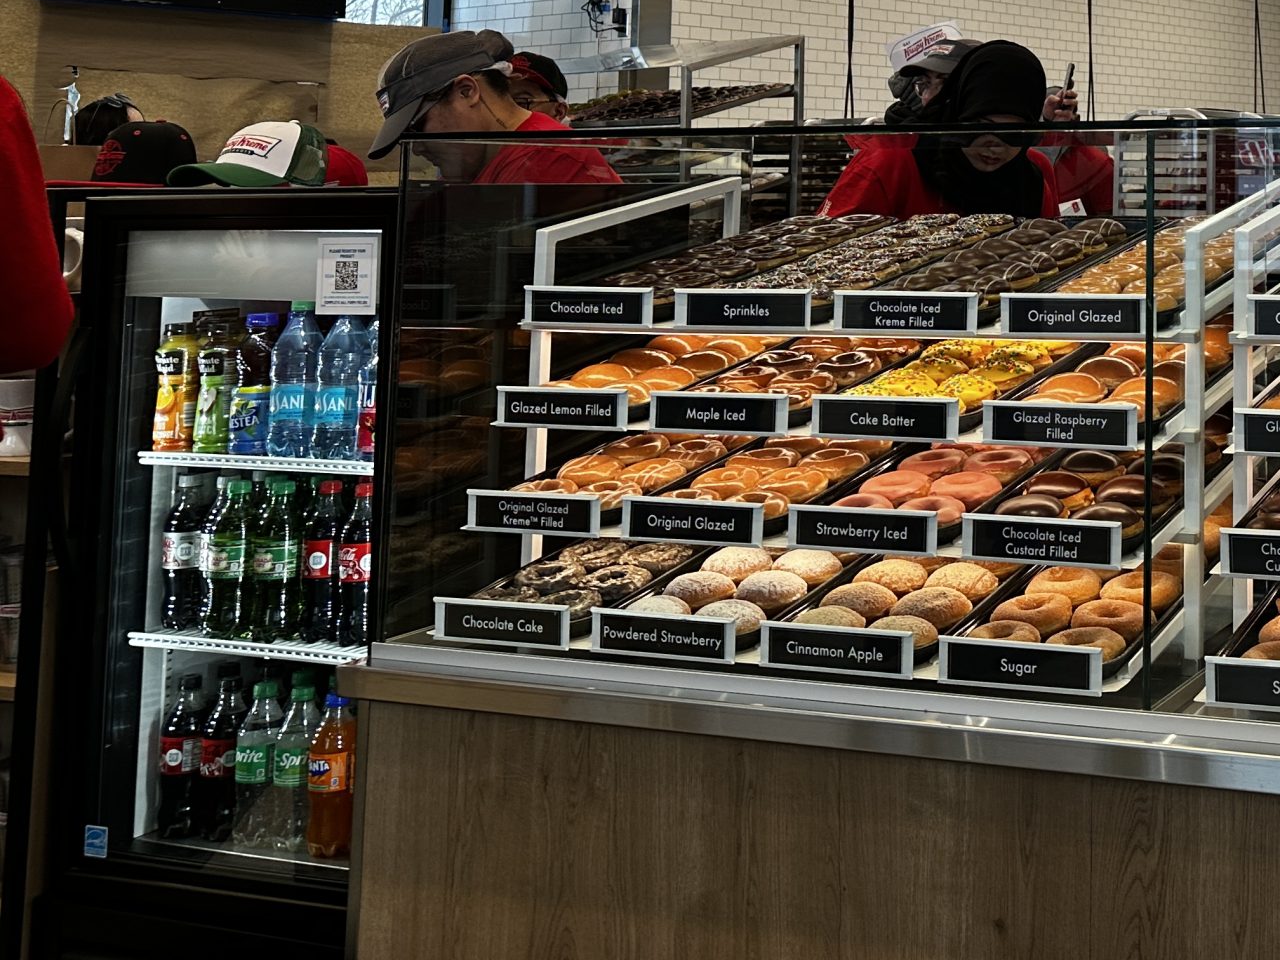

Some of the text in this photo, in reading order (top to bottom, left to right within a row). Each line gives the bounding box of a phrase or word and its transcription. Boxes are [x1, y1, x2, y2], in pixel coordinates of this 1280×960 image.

[550, 301, 623, 314] Chocolate Iced
[723, 304, 770, 319] Sprinkles
[869, 301, 941, 313] Chocolate Iced
[875, 316, 934, 327] Kreme Filled
[1028, 309, 1121, 325] Original Glazed
[511, 401, 611, 416] Glazed Lemon Filled
[686, 407, 746, 423] Maple Iced
[229, 415, 260, 429] ESTEA
[850, 412, 915, 427] Cake Batter
[1013, 411, 1107, 429] Glazed Raspberry
[1046, 428, 1073, 440] Filled
[498, 500, 569, 514] Original Glazed
[541, 516, 563, 528] Filled
[647, 514, 735, 531] Original Glazed
[816, 522, 907, 541] Strawberry Iced
[1002, 527, 1081, 543] Chocolate Iced
[1005, 543, 1077, 559] Custard Filled
[462, 615, 543, 633] Chocolate Cake
[603, 626, 722, 651] Powdered Strawberry
[786, 641, 883, 663] Cinnamon Apple
[1000, 658, 1037, 677] Sugar
[235, 749, 263, 764] prite
[308, 759, 329, 773] ANTA
